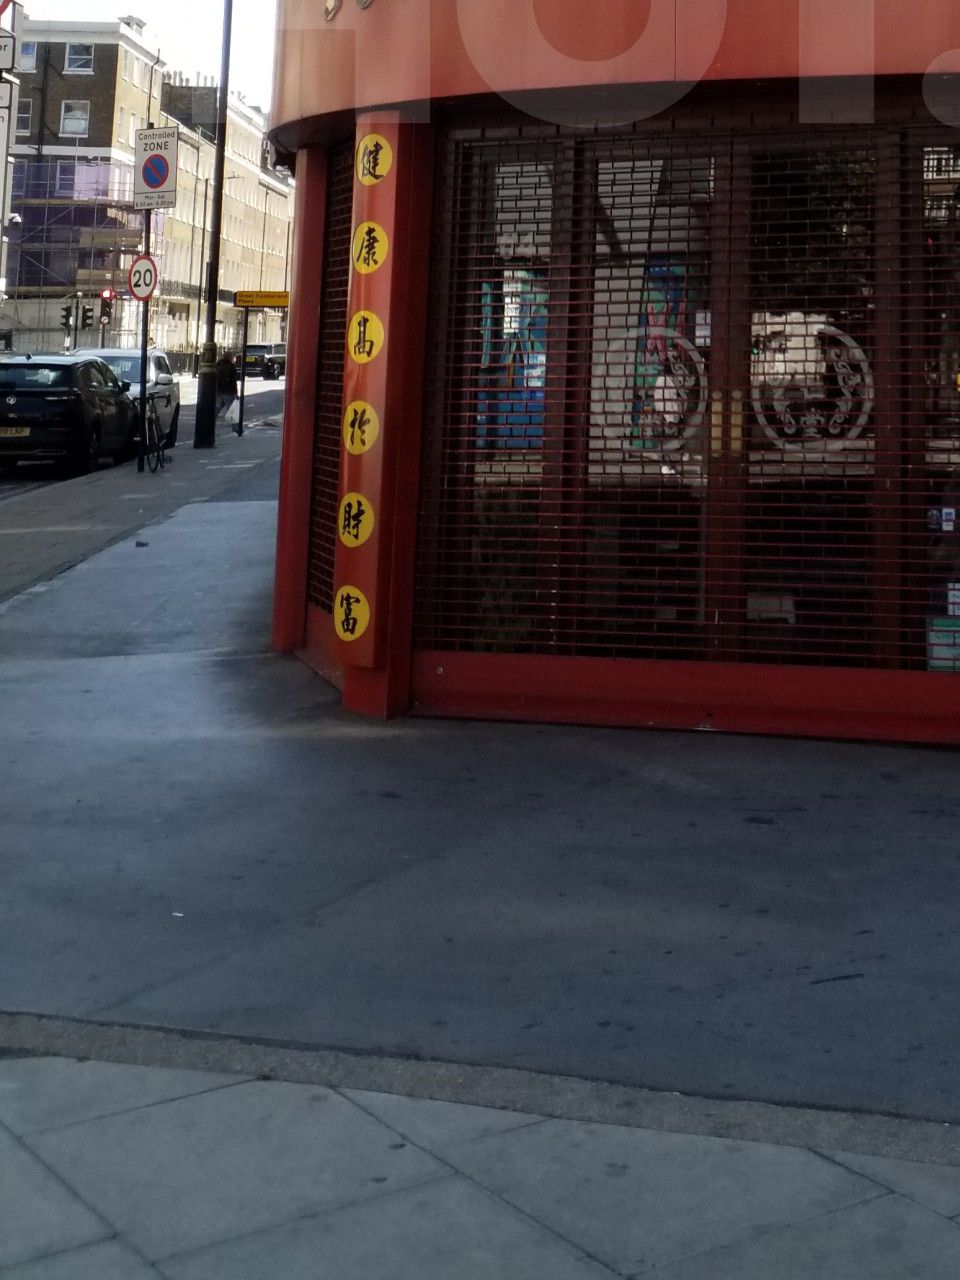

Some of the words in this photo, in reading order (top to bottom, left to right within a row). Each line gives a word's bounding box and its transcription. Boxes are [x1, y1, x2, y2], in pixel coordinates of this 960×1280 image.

[138, 130, 175, 141] Controlled
[143, 141, 169, 151] ZONE
[133, 268, 153, 289] 20
